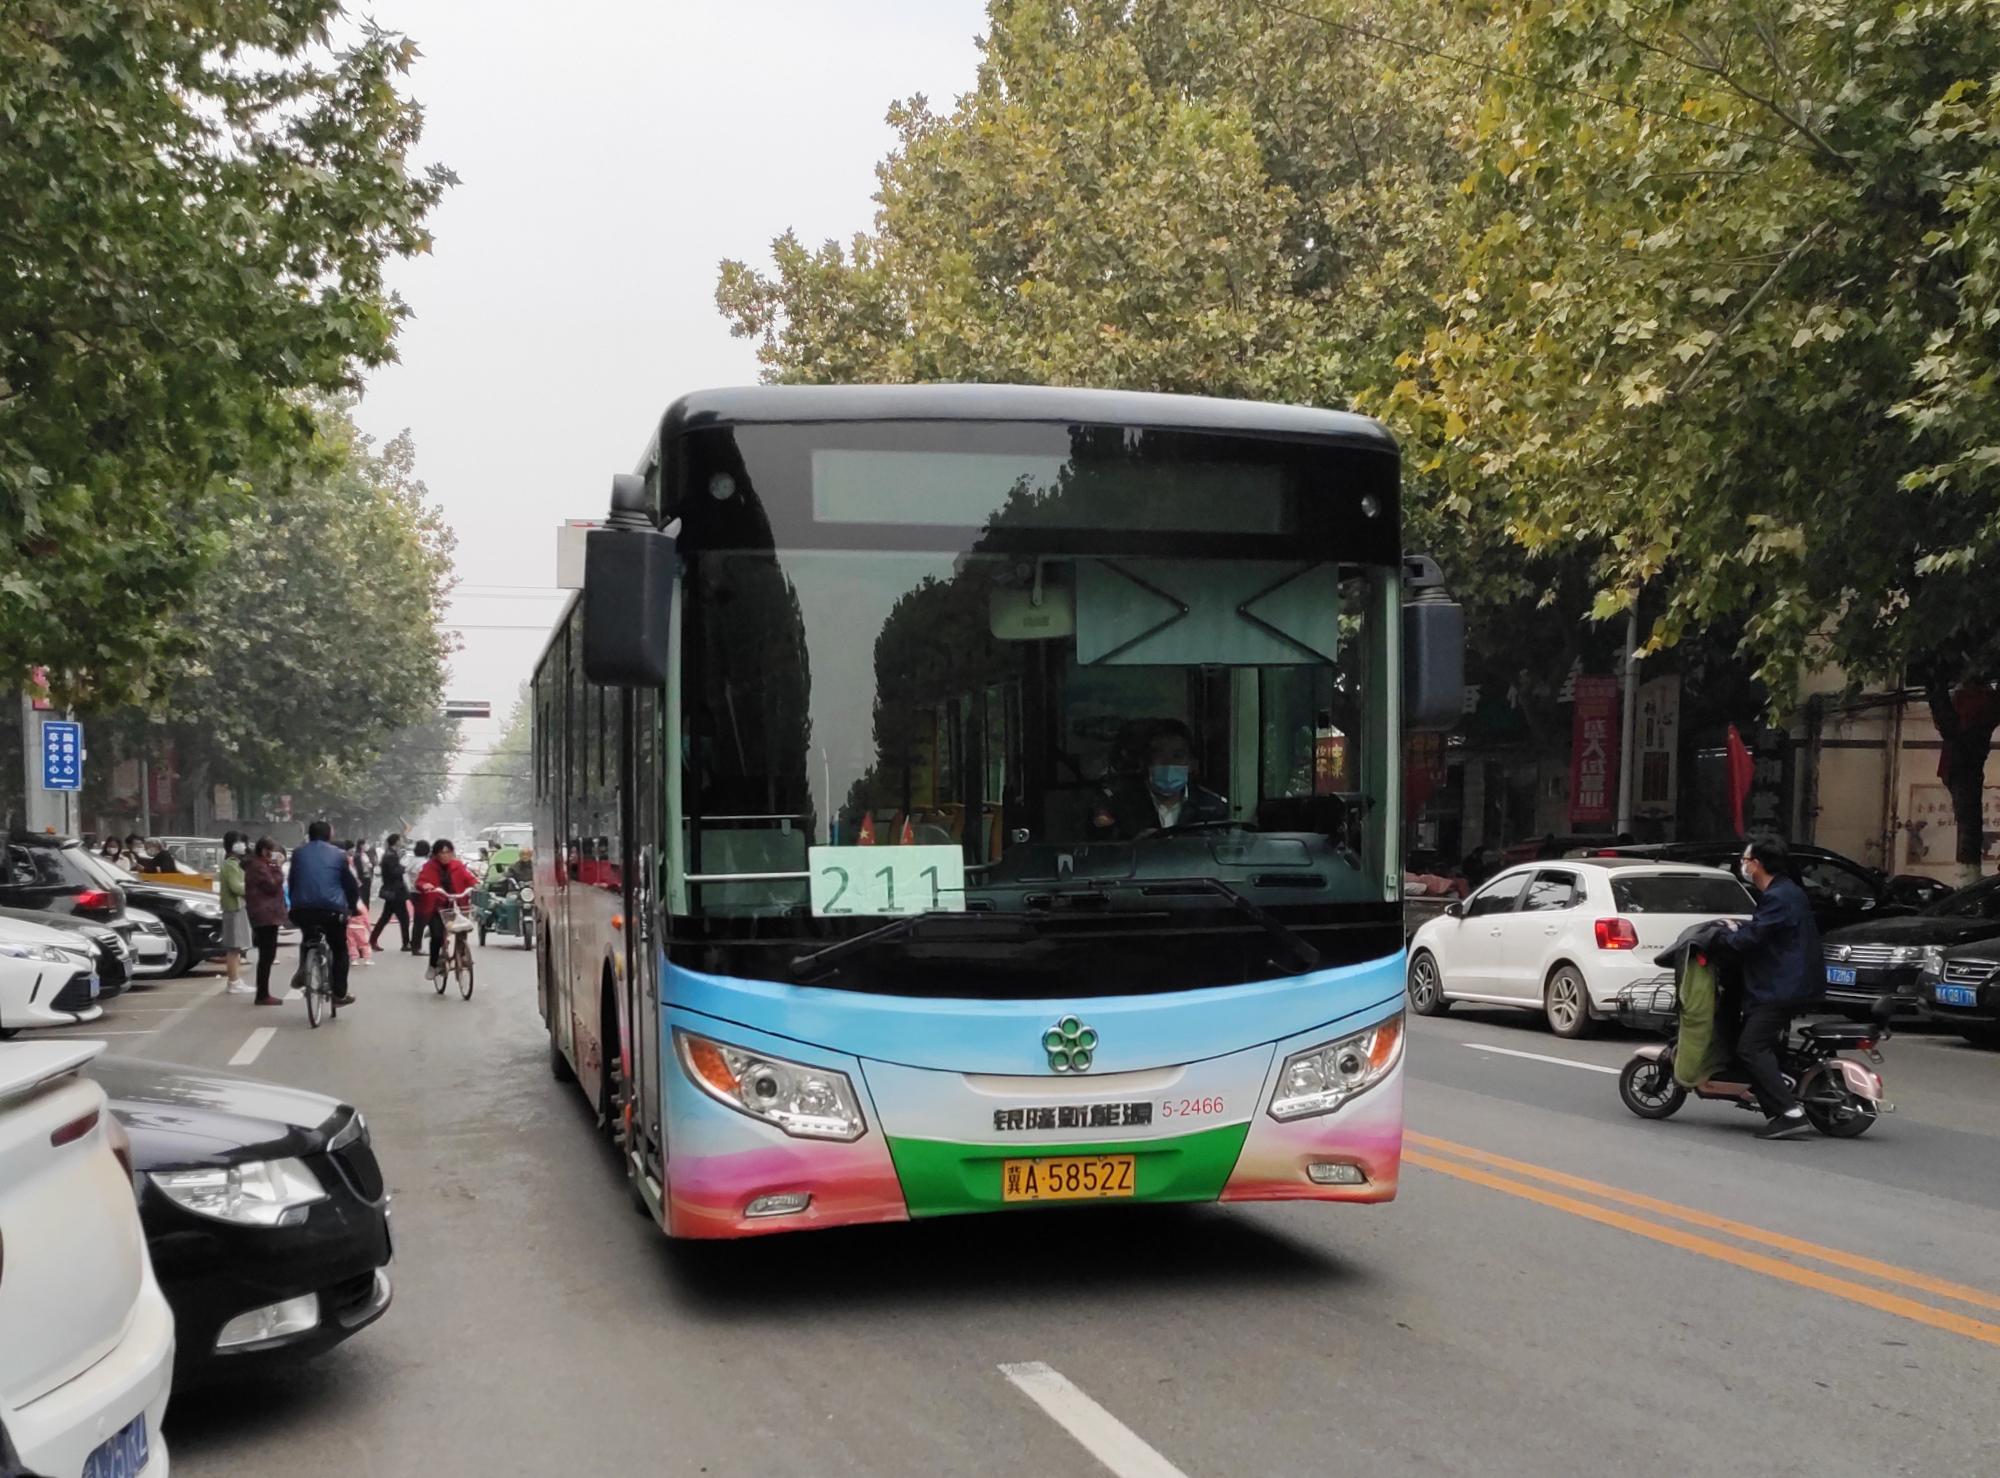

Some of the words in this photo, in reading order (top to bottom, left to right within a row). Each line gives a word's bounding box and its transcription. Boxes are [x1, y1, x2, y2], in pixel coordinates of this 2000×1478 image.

[822, 866, 948, 914] 211
[993, 1102, 1153, 1131] 银隆新能源
[1162, 1096, 1224, 1118] 5-2466
